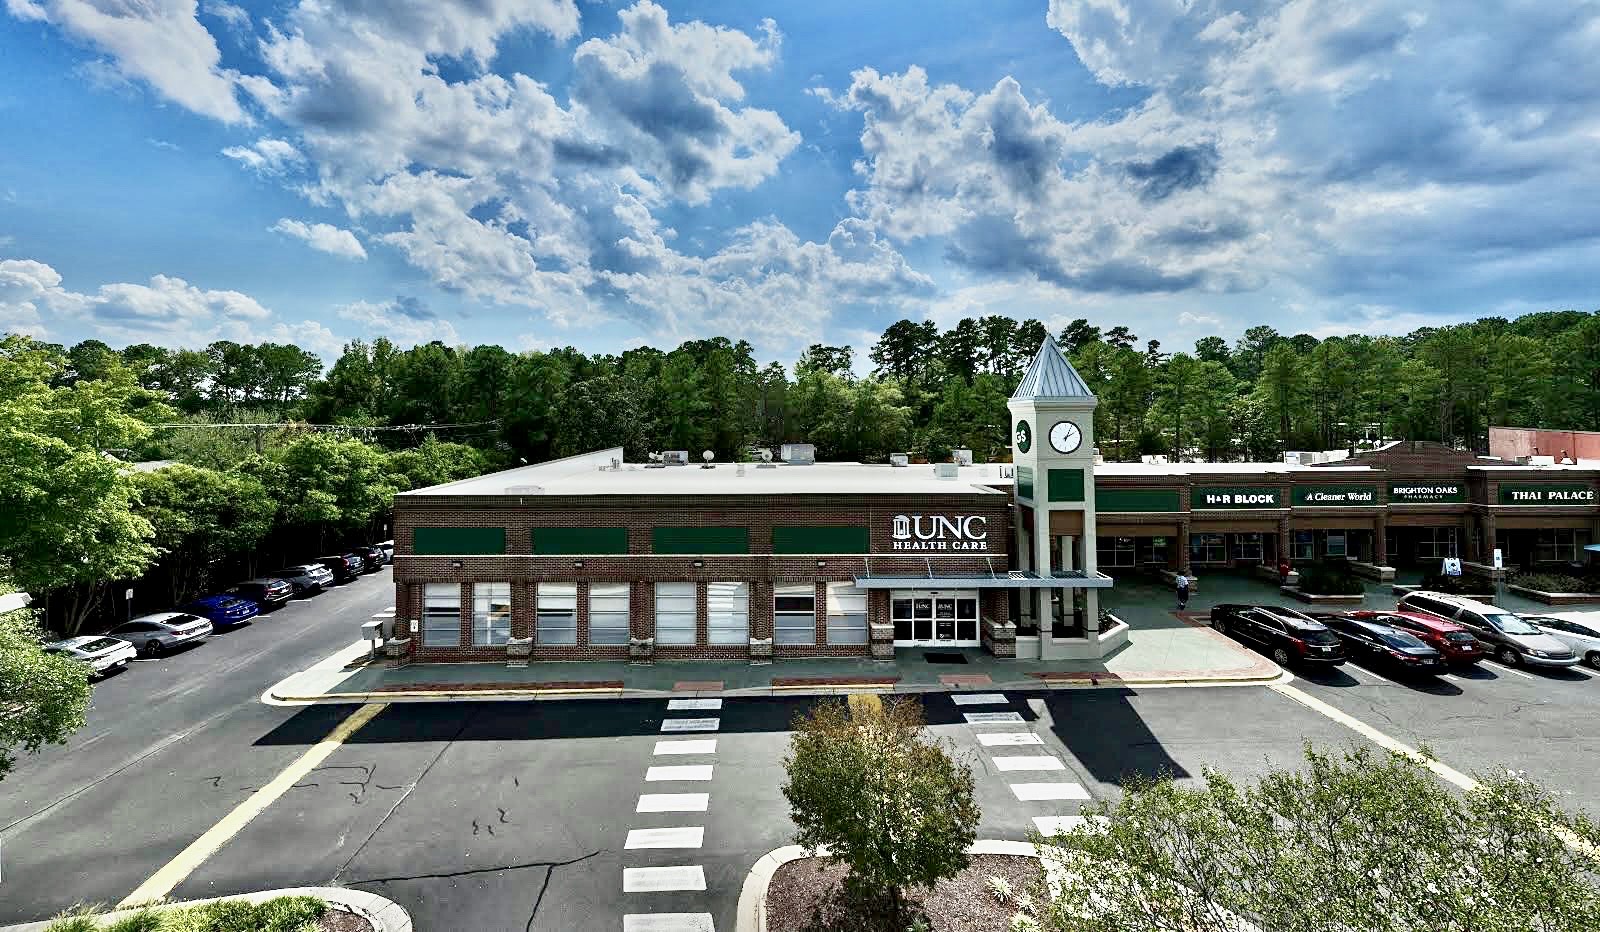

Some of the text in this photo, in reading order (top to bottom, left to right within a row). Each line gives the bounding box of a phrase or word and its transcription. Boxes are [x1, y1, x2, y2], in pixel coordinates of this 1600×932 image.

[1435, 486, 1458, 494] OAKS
[1206, 494, 1274, 504] H&R BLOCK
[1306, 492, 1372, 501] A Cleaner World
[1511, 490, 1594, 500] THAI PALACE
[911, 515, 987, 540] UNC
[893, 541, 988, 550] HEALTH CARE
